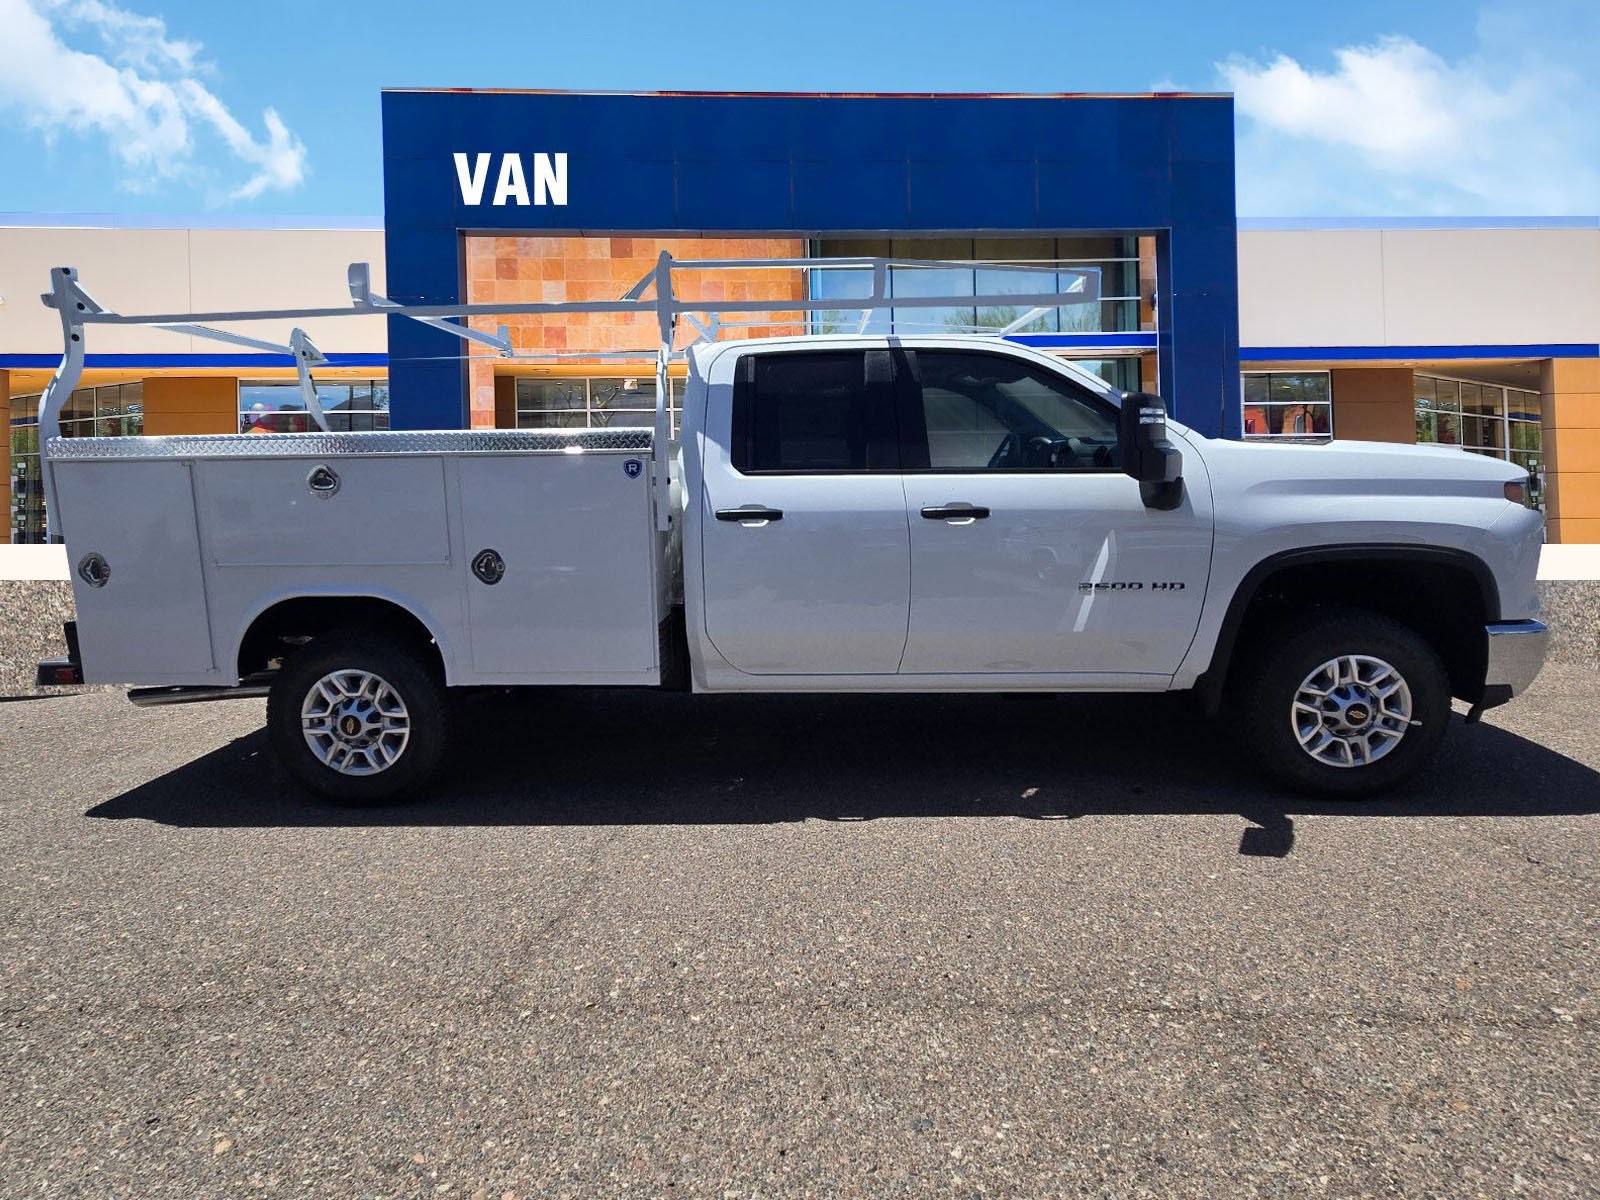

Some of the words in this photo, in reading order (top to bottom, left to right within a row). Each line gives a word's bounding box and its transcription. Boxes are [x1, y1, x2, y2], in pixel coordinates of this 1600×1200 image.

[453, 153, 568, 206] VAN
[628, 463, 638, 473] R
[1151, 581, 1186, 591] HD
